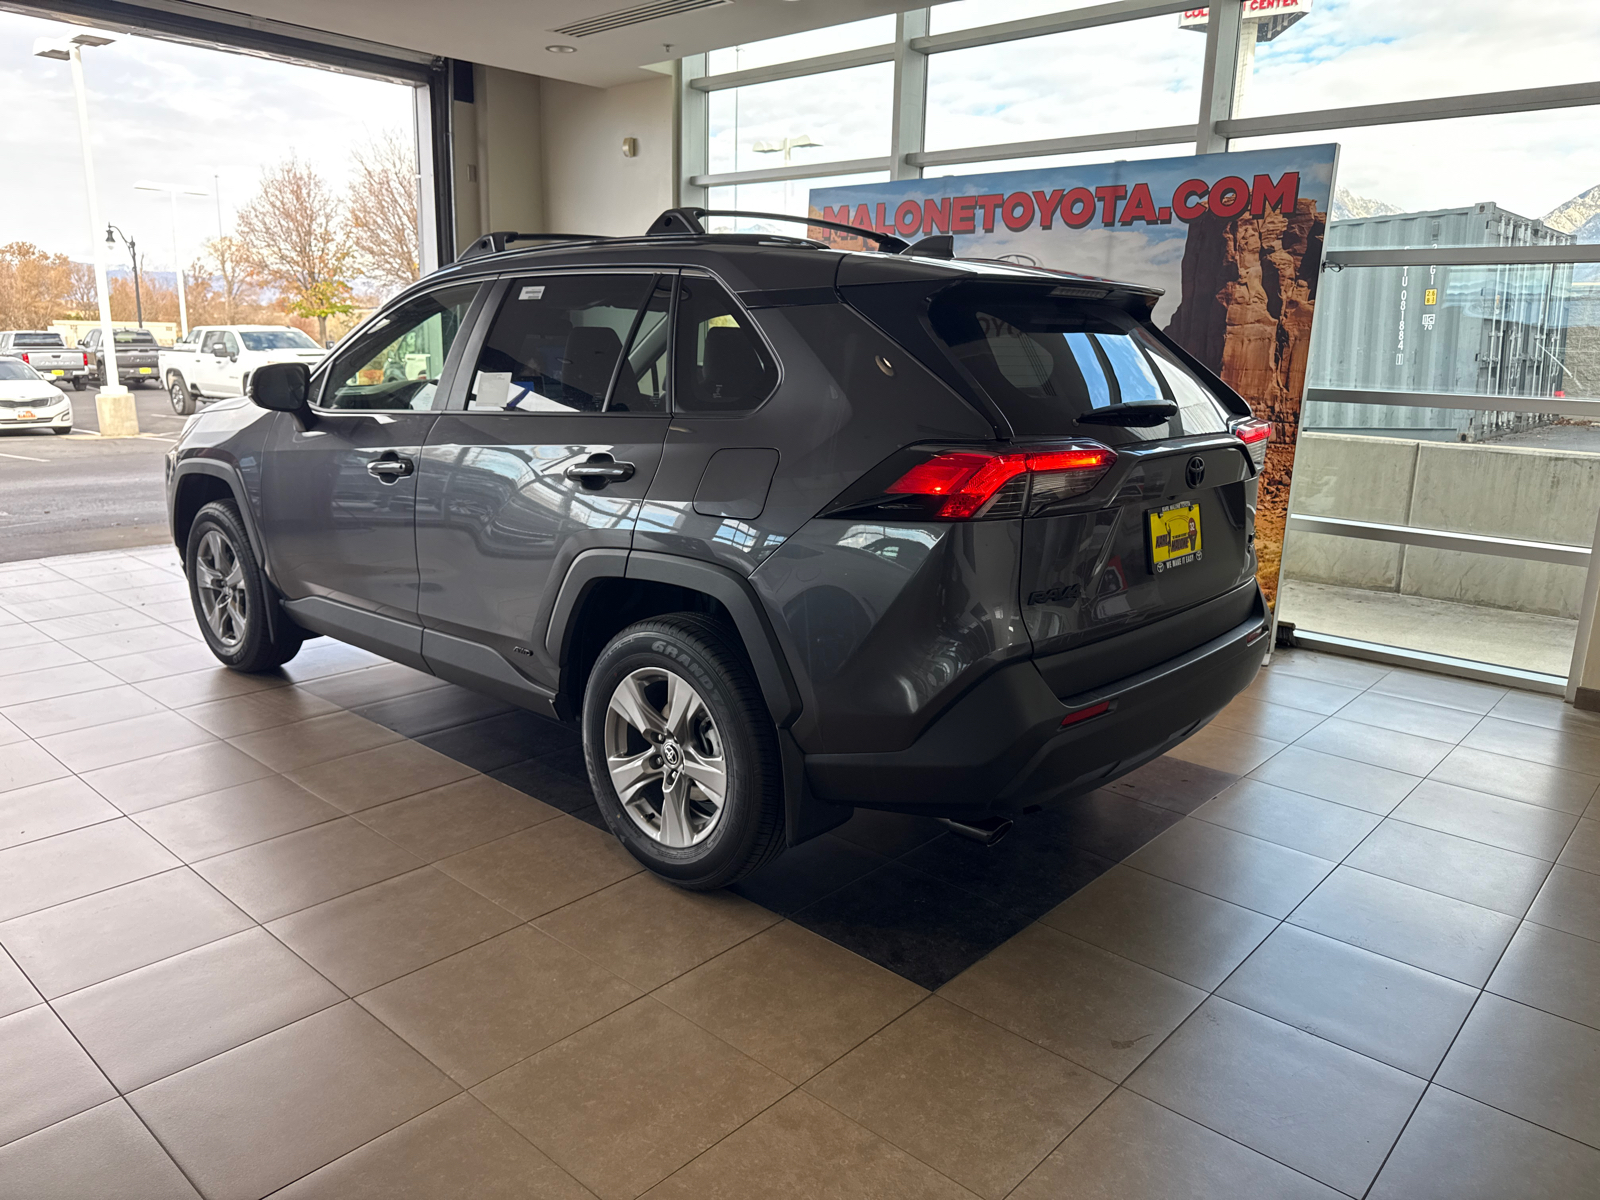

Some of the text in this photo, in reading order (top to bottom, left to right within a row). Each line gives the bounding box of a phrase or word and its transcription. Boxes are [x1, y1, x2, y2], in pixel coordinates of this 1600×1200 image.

[1250, 0, 1299, 11] CENTER
[822, 171, 1301, 238] MALONETOYOTA.COM
[1189, 522, 1196, 531] 32
